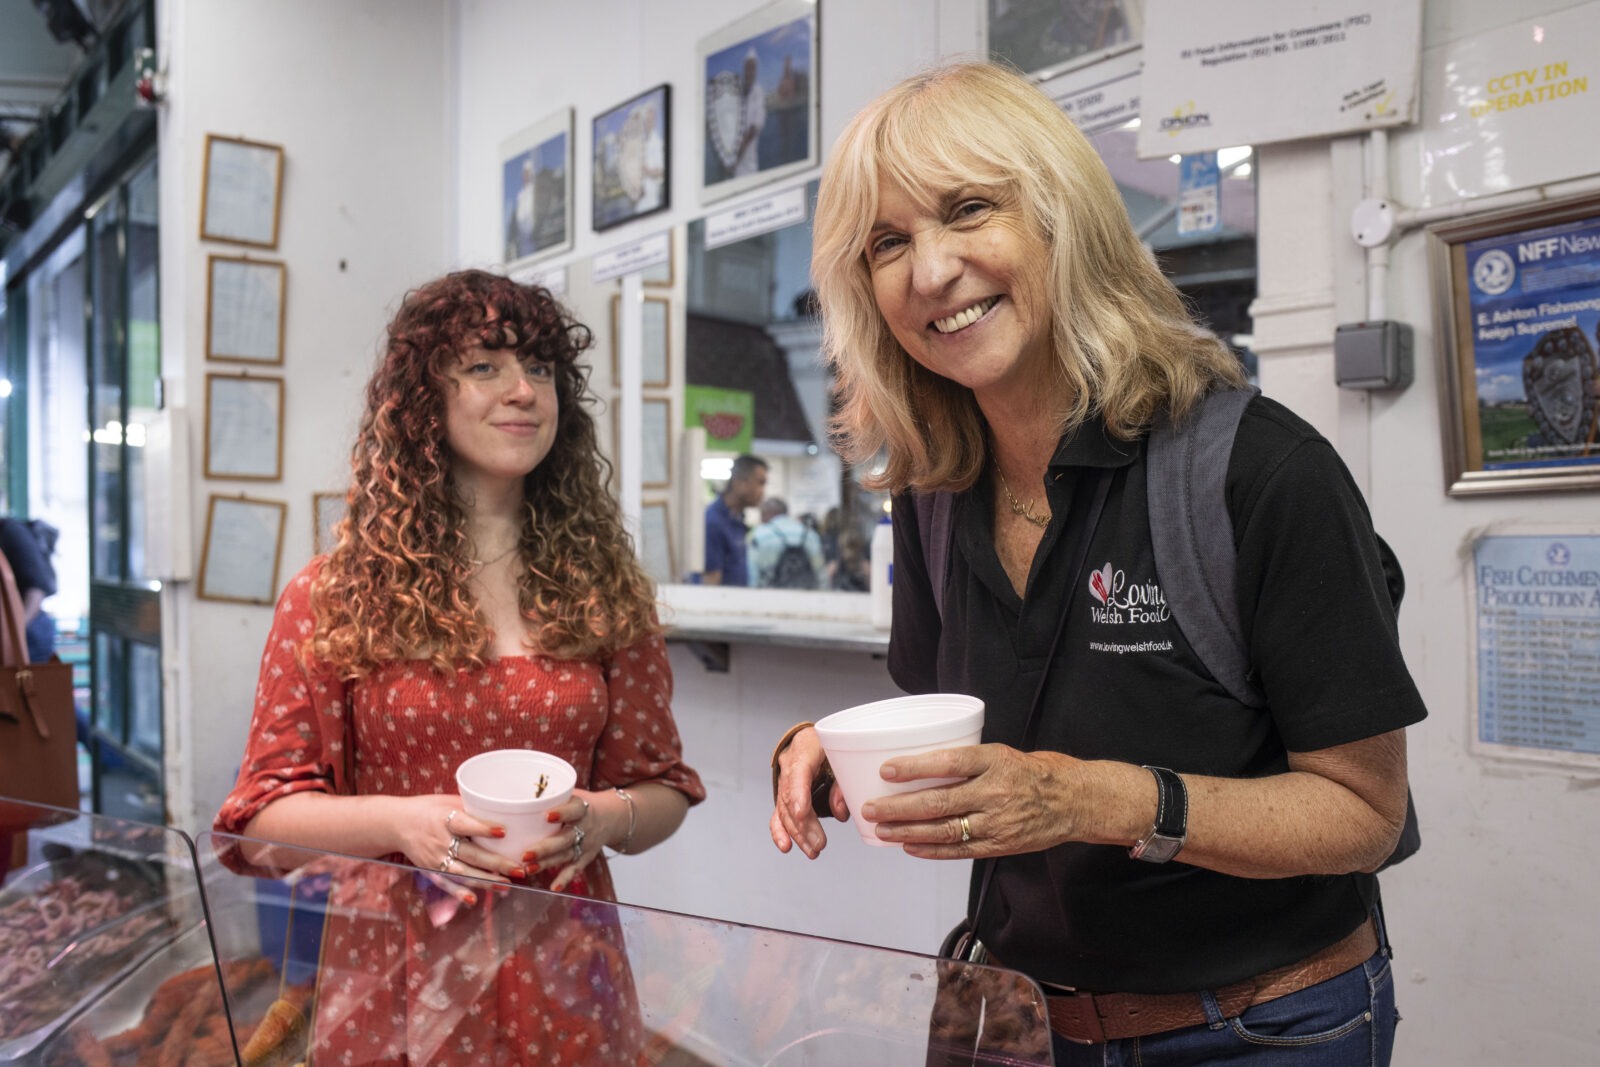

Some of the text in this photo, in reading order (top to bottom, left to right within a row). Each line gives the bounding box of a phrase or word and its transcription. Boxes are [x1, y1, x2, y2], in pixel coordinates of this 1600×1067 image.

[1487, 60, 1569, 95] CCTV IN
[1470, 75, 1588, 118] OPERATION
[1518, 237, 1560, 264] NFF
[1091, 606, 1123, 624] Welsh
